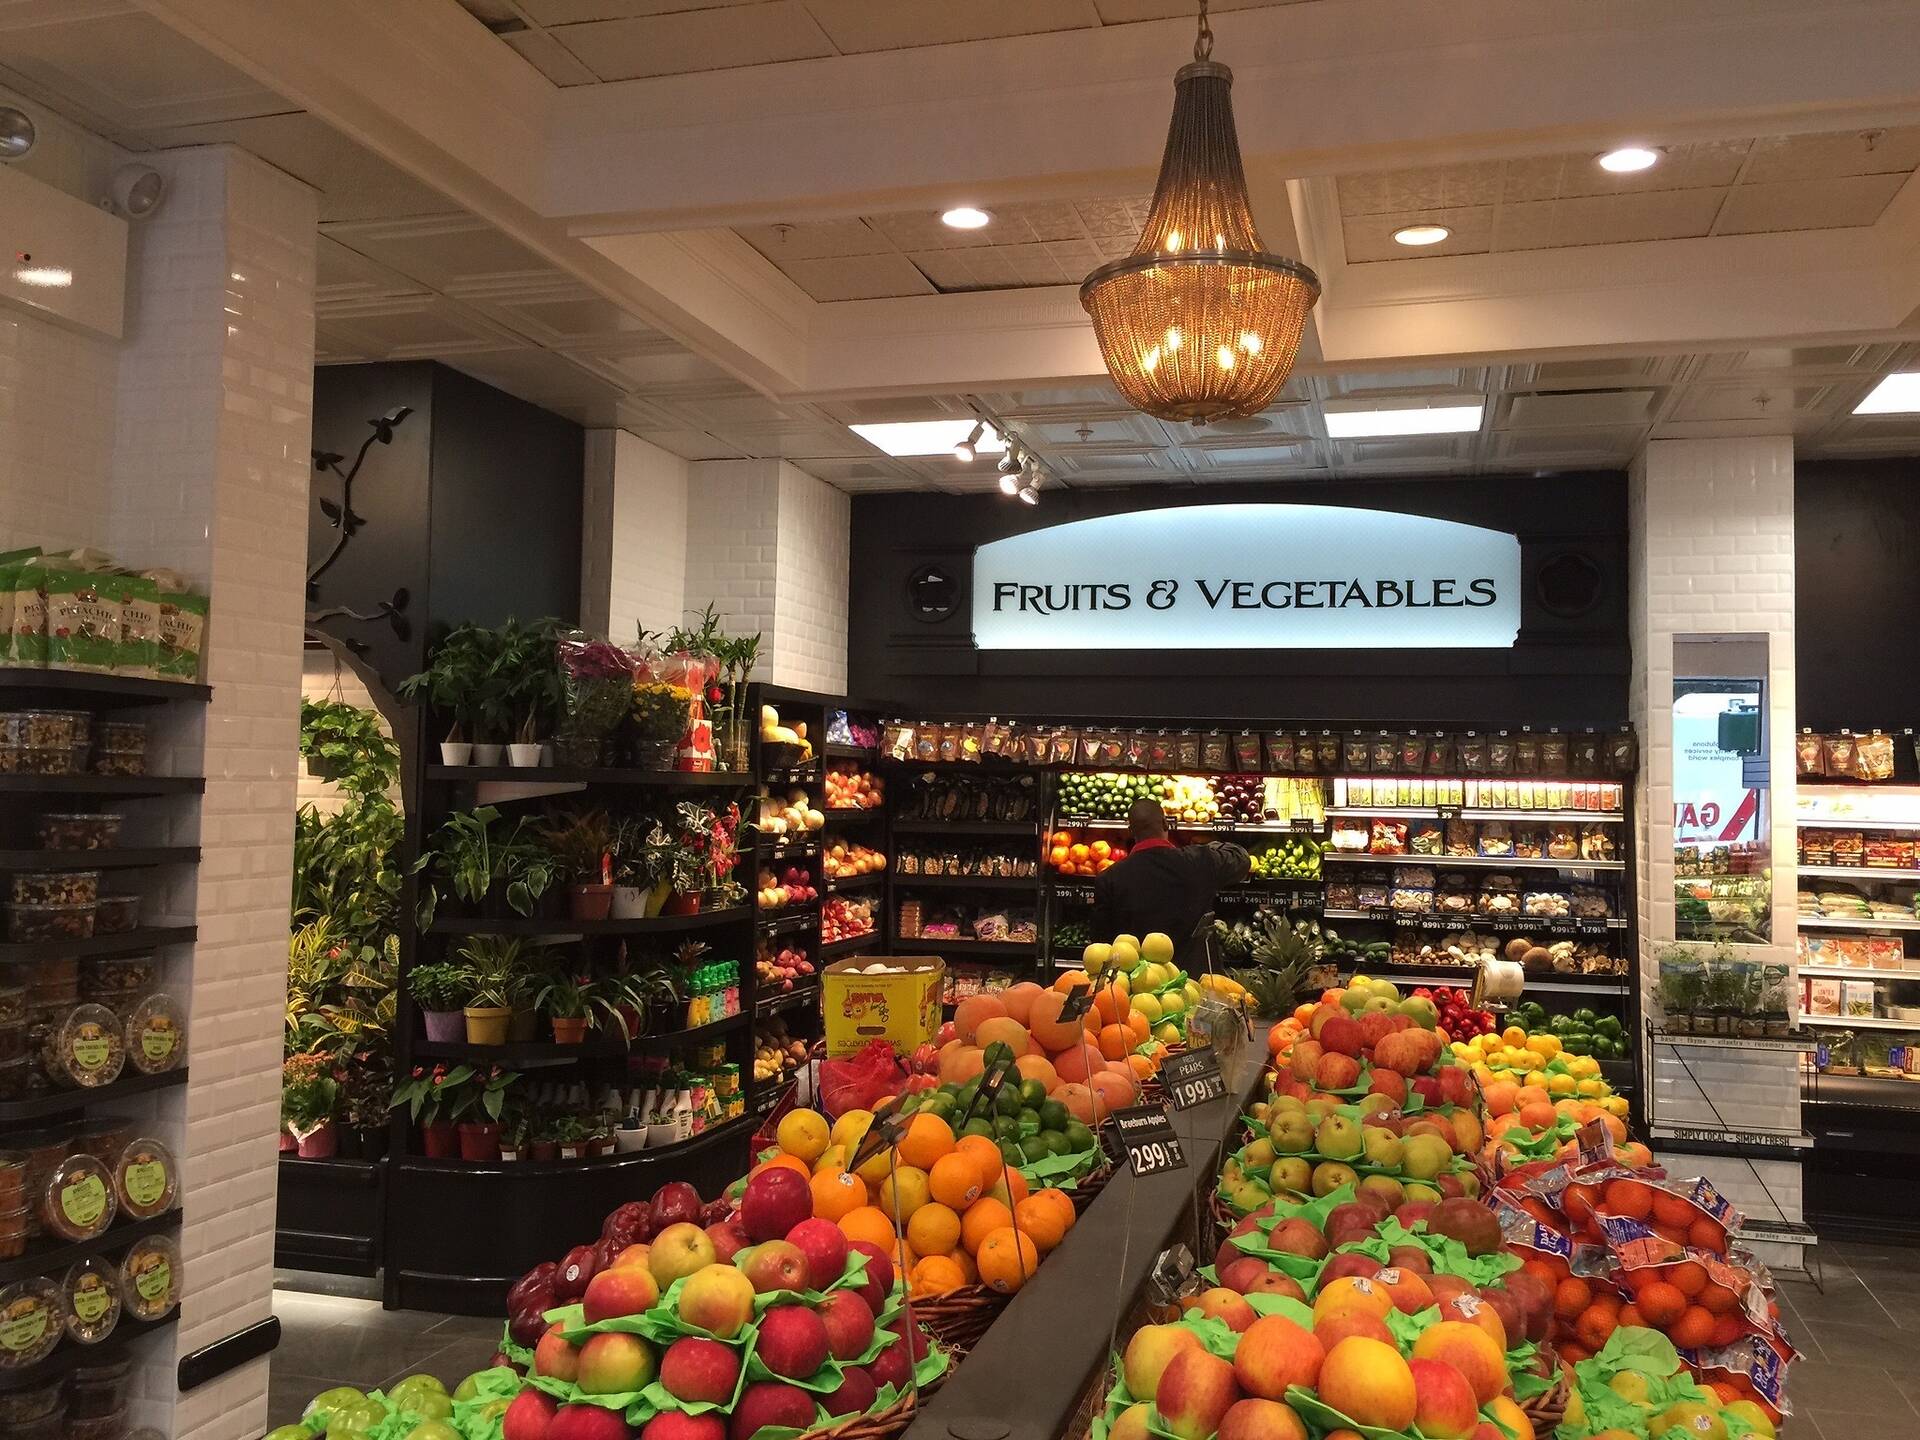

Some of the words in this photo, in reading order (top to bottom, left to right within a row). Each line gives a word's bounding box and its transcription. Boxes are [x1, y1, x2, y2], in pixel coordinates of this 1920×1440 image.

[993, 582, 1131, 615] FRUITS
[1146, 579, 1179, 610] &
[1194, 577, 1497, 610] VEGETABLES
[1179, 1061, 1205, 1076] PEARS
[1175, 1080, 1207, 1108] 1.99
[1119, 1118, 1148, 1129] Braeburn
[1146, 1114, 1167, 1126] Apples
[1673, 1130, 1701, 1140] SIMPLY
[1702, 1132, 1727, 1141] LOCAL
[1735, 1133, 1763, 1144] SIMPLY
[1765, 1135, 1790, 1146] FRESH
[1131, 1142, 1165, 1173] 2.99
